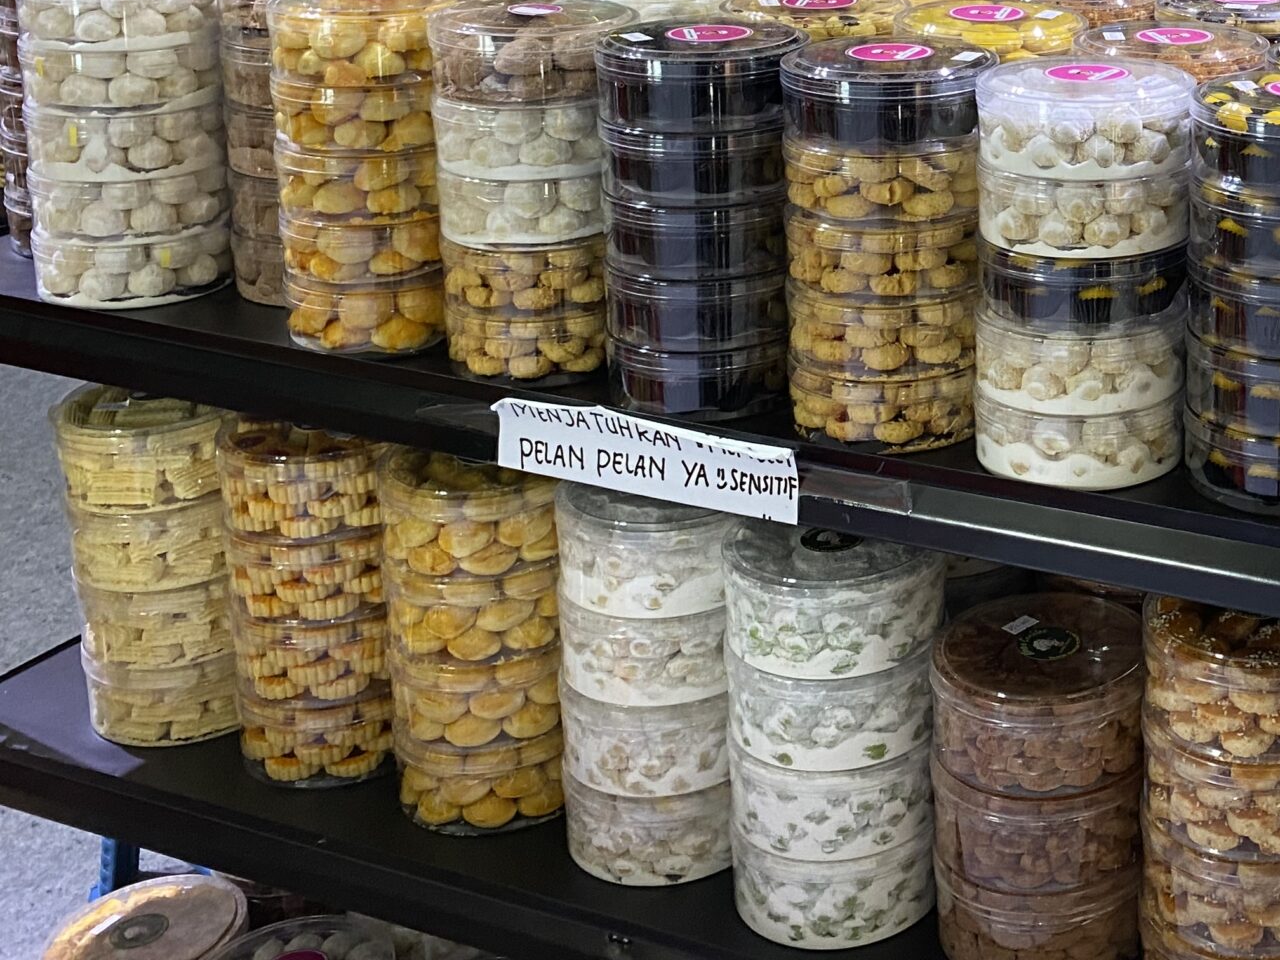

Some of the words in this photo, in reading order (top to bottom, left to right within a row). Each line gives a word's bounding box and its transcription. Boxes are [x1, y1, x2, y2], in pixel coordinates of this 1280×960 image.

[510, 402, 683, 451] MENJATUHKAN
[519, 437, 585, 470] PELAN
[597, 448, 666, 481] PELAN
[681, 459, 710, 488] YA
[729, 469, 798, 500] SENSITIF
